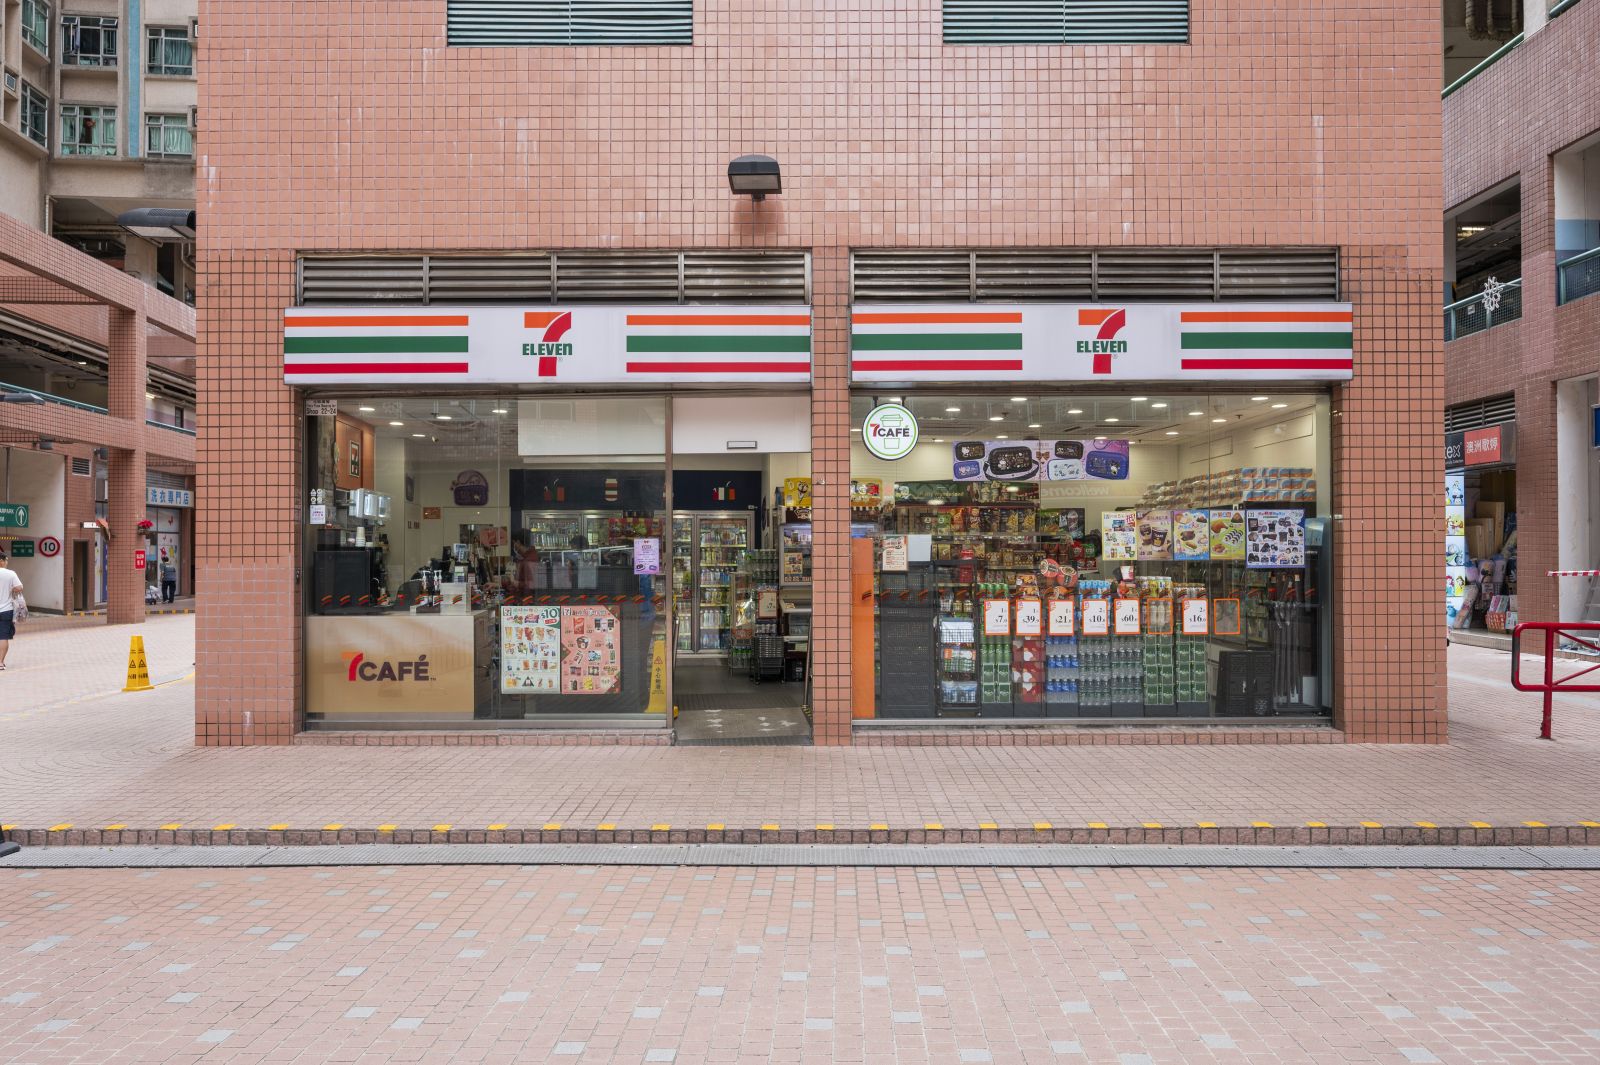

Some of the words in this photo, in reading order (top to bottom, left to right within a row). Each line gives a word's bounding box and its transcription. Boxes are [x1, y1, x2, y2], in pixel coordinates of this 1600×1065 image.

[146, 488, 189, 505] 洗衣專門店
[44, 542, 56, 552] 10
